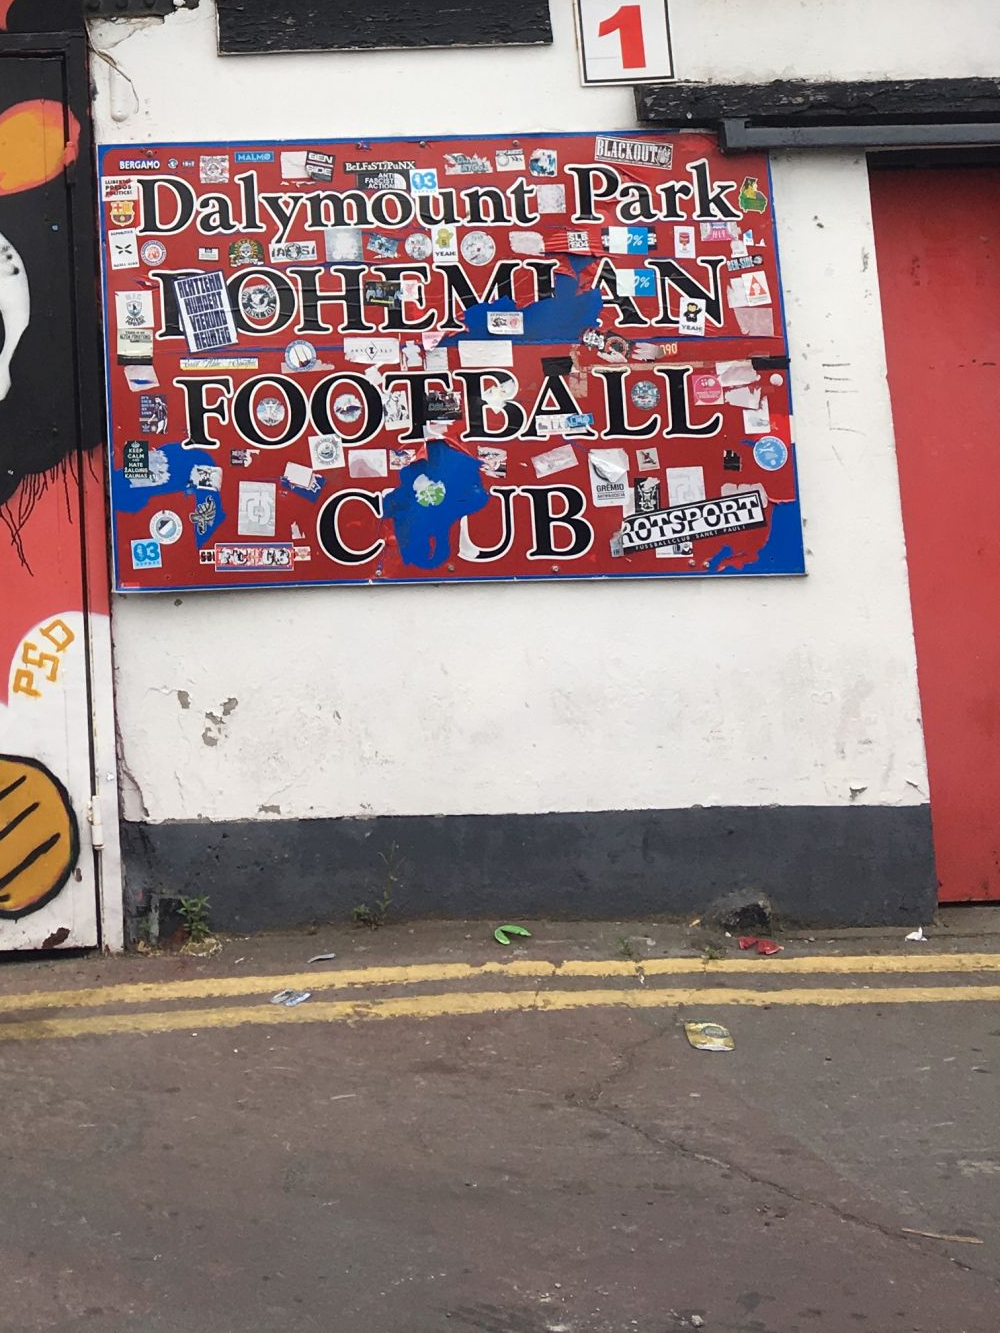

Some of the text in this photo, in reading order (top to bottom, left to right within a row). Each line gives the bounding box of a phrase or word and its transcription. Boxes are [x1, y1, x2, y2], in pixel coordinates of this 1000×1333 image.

[598, 4, 646, 69] 1
[119, 160, 160, 170] BERGAMO
[307, 152, 334, 164] BEN
[597, 137, 658, 162] BLACKOUT
[136, 158, 745, 245] Dalymount Park
[172, 364, 723, 450] FOOTBALL
[317, 482, 595, 566] CUB
[621, 495, 760, 545] ROTSPORT
